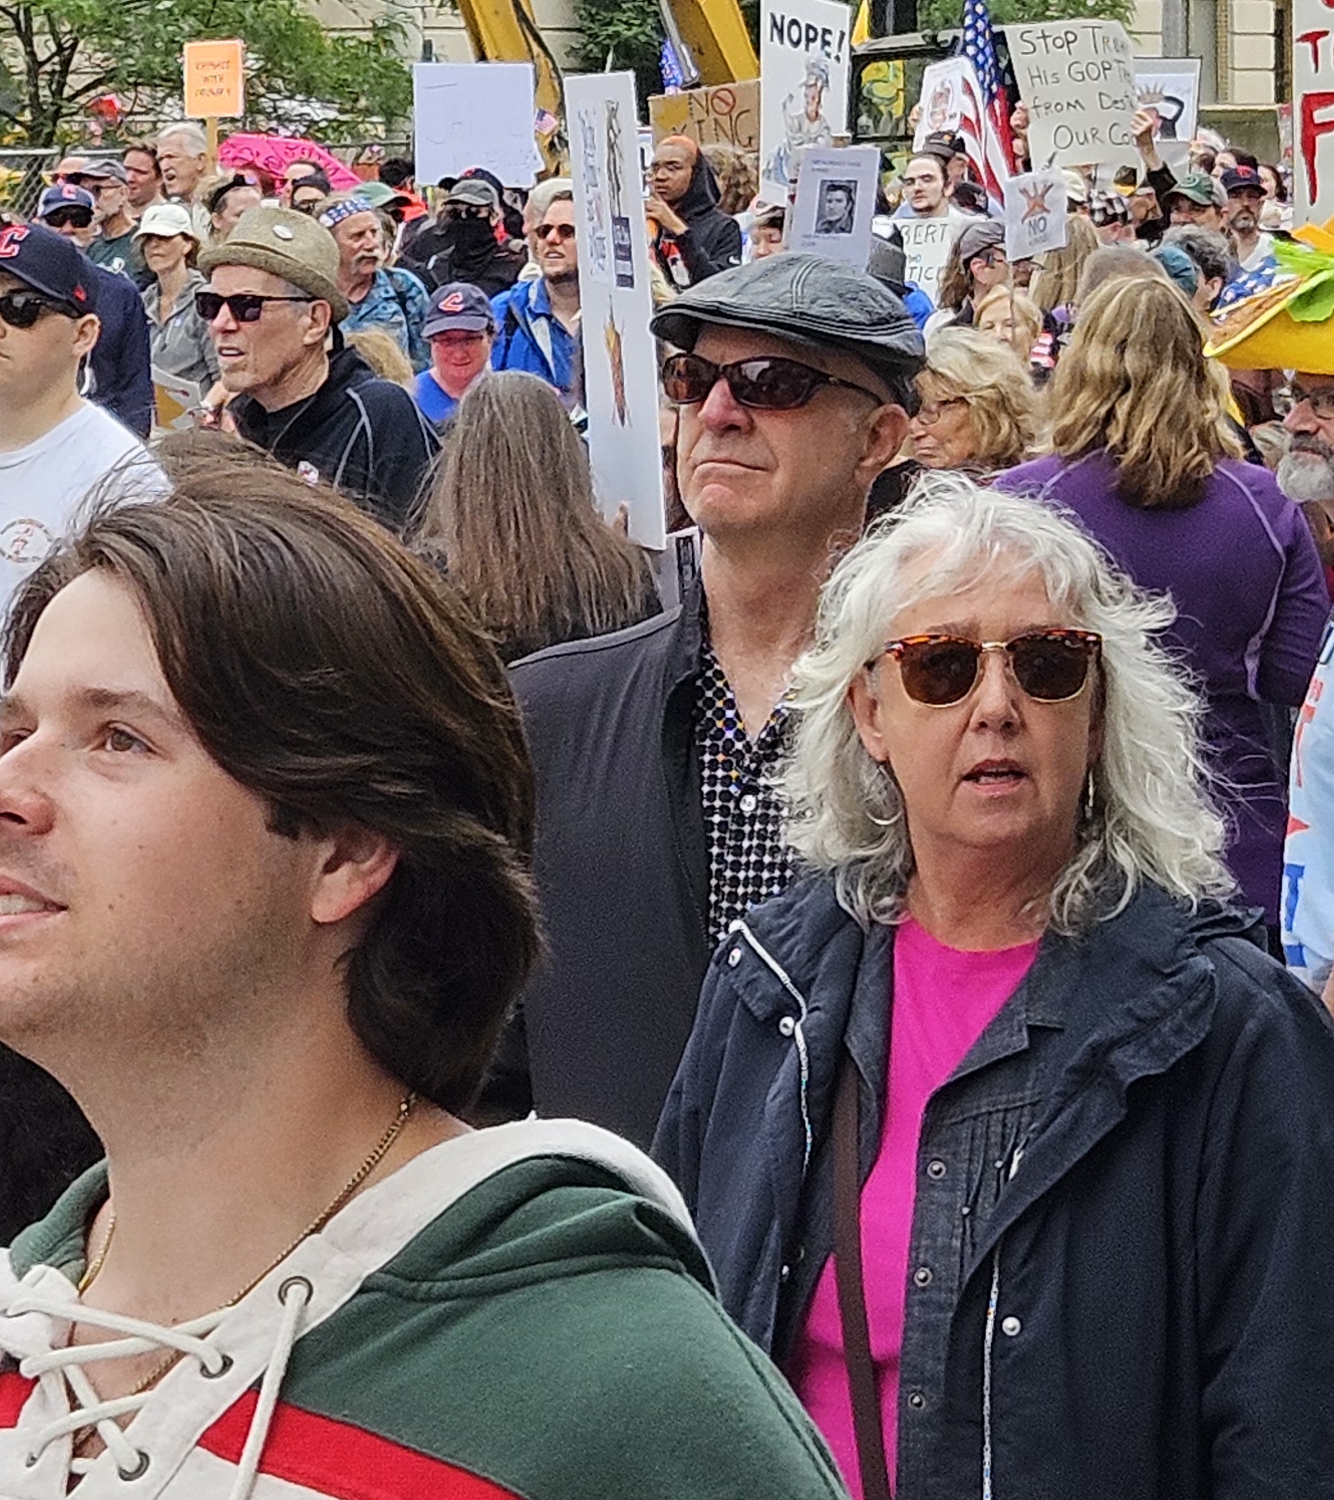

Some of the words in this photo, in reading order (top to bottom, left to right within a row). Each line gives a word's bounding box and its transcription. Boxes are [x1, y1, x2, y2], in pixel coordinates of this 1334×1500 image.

[769, 11, 845, 62] NOPE!
[1067, 59, 1113, 83] GOP
[438, 291, 465, 312] C
